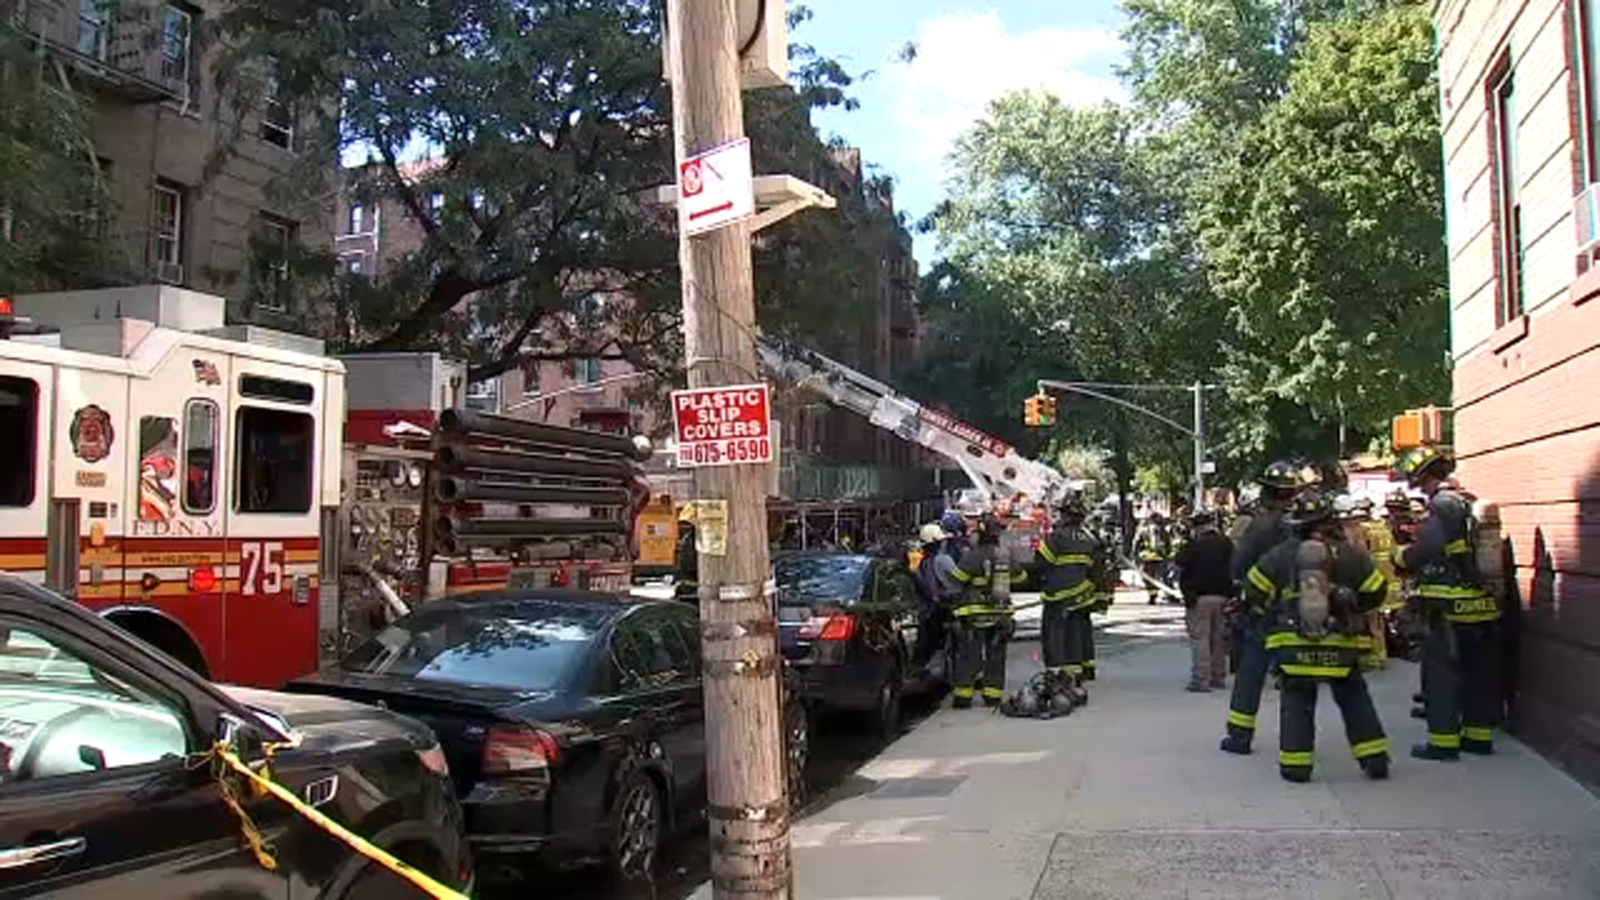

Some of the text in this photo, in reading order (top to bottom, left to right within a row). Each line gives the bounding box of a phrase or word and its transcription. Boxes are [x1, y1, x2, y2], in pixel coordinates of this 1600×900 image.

[679, 391, 760, 411] PLASTIC
[697, 407, 741, 423] SLIP
[684, 420, 761, 439] COVERS
[132, 519, 221, 536] F.D.N.Y.
[241, 541, 283, 596] 75
